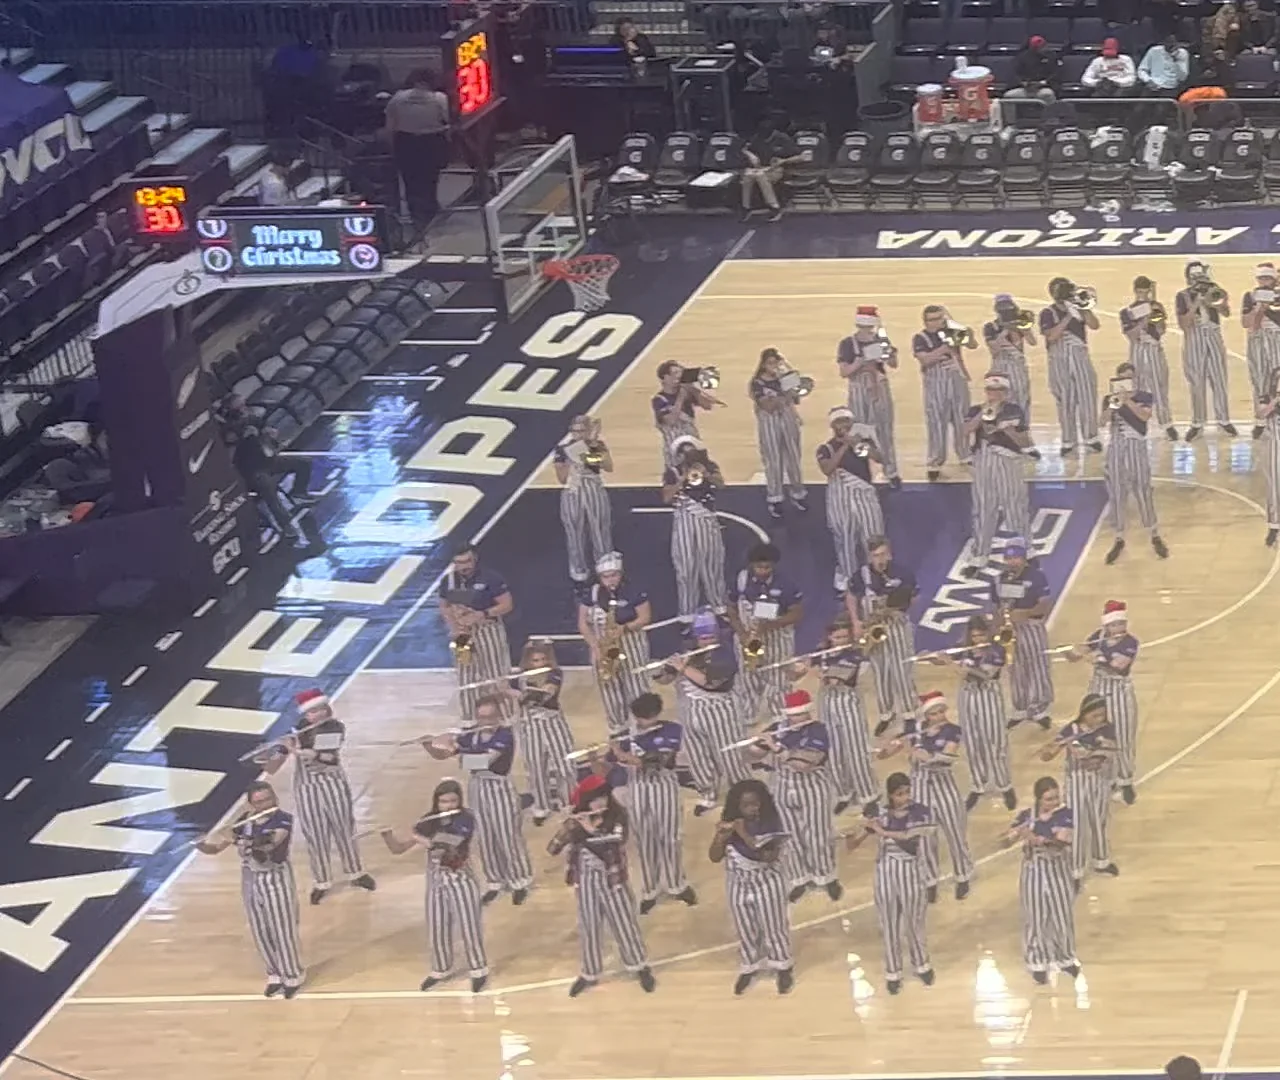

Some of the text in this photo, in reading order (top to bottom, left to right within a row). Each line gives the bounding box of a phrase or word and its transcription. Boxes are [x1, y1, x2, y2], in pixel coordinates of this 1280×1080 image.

[458, 59, 489, 112] 30
[144, 205, 185, 232] 30
[251, 225, 323, 249] Merry
[875, 225, 1251, 250] ARIZONA
[0, 311, 643, 973] ANTELOPES
